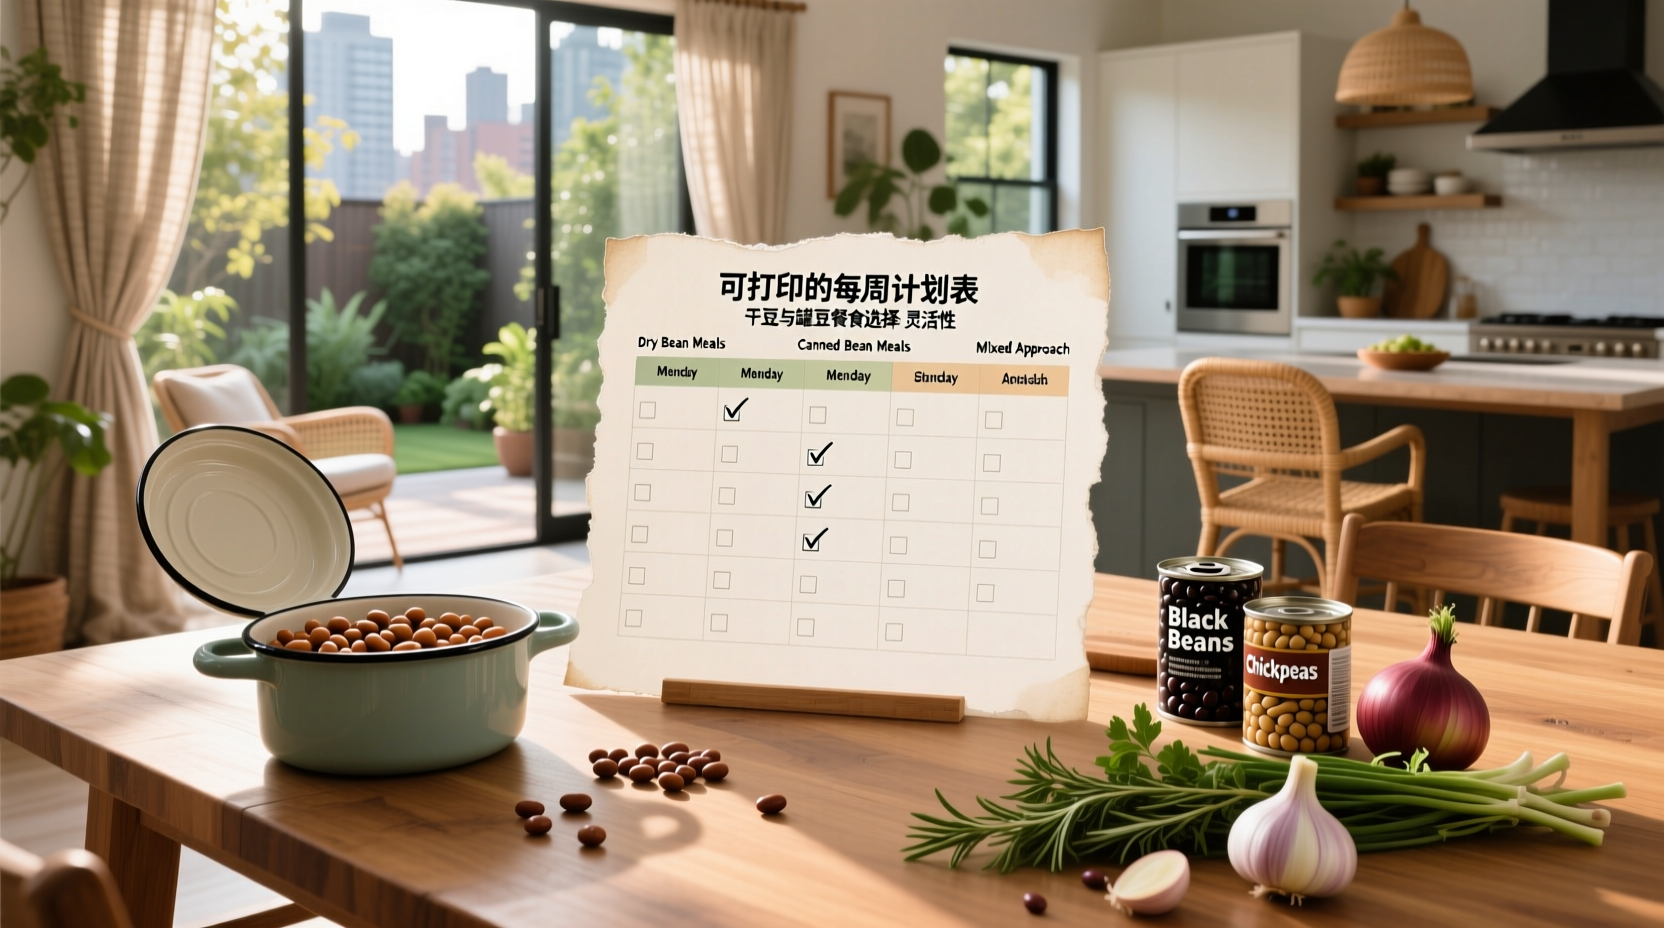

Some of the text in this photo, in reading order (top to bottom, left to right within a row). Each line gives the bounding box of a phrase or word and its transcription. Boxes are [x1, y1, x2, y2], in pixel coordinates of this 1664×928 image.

[719, 271, 979, 305] 可打印的每周计划表
[904, 309, 957, 330] 灵活性
[638, 336, 726, 351] Dry Bean Meals
[797, 338, 911, 353] Canned Bean Meals
[1014, 341, 1070, 358] Approach
[1168, 605, 1229, 630] Black
[1168, 628, 1234, 653] Beans
[1246, 653, 1319, 684] Chickpeas
